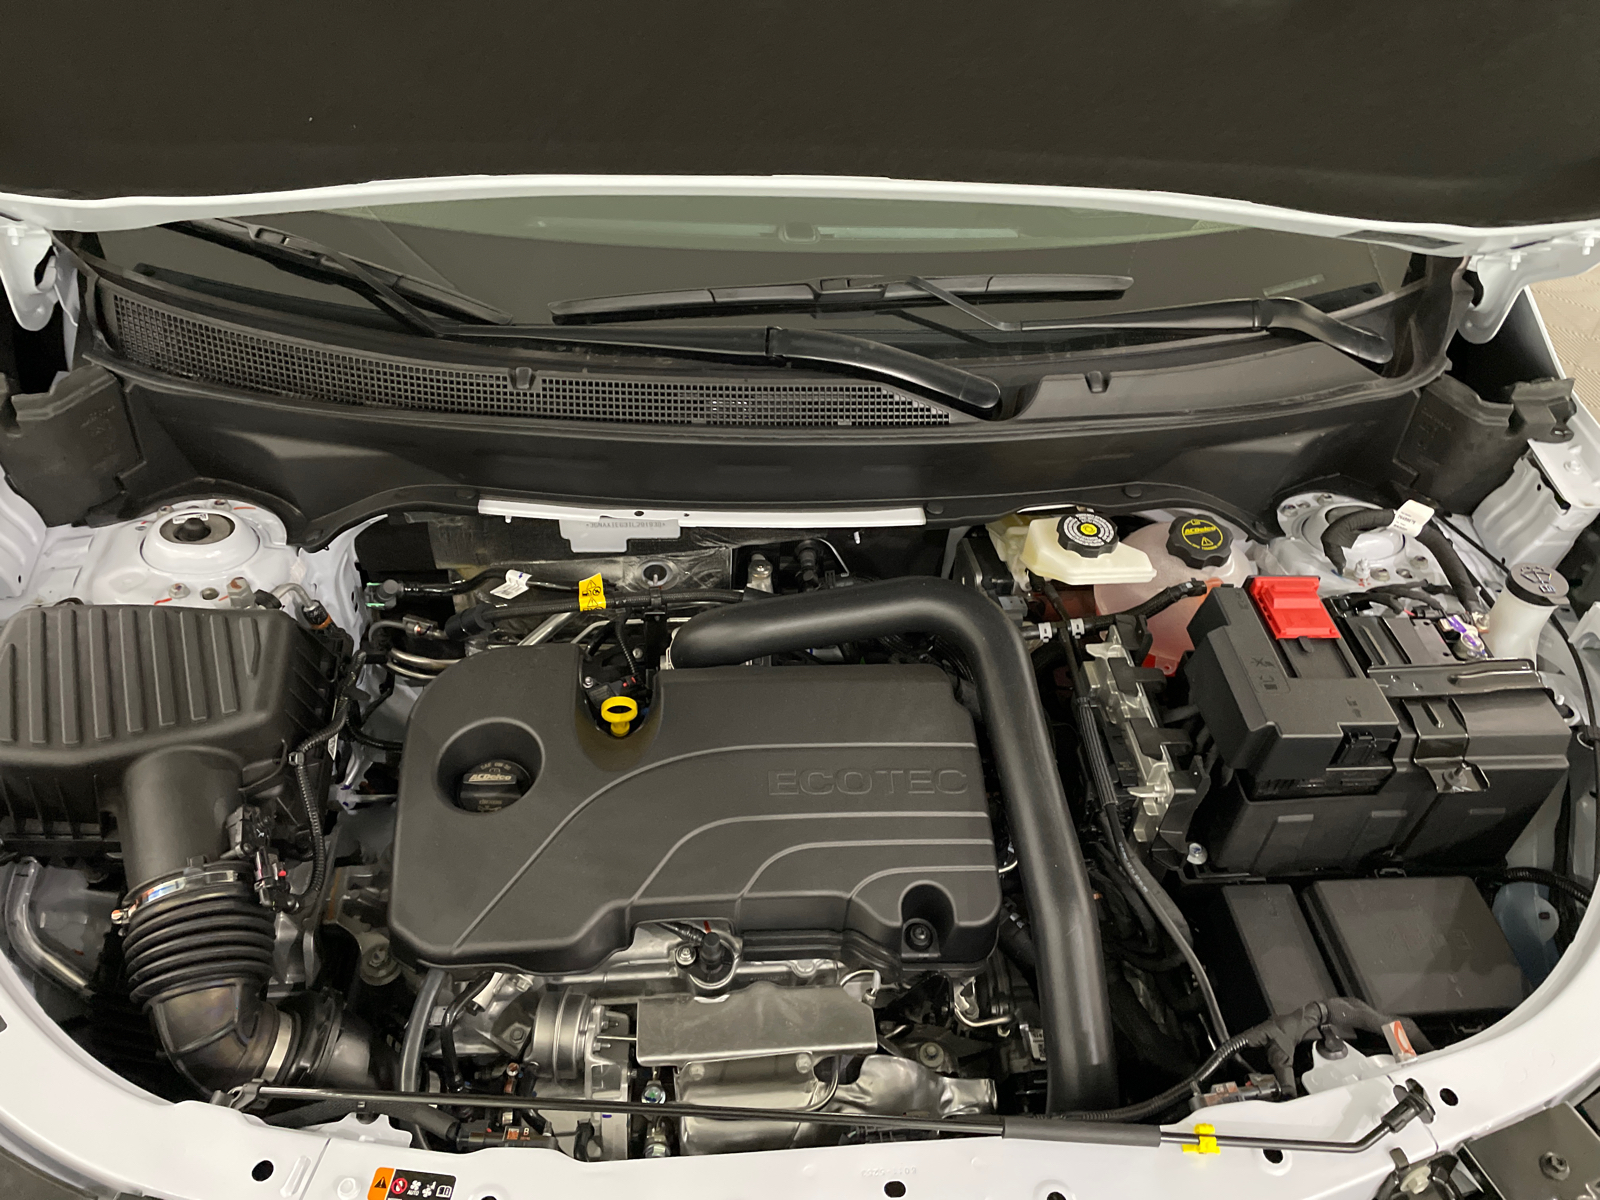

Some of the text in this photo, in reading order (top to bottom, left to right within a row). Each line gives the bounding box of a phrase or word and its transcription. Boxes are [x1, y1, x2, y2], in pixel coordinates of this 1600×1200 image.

[468, 772, 513, 782] ACDelco
[767, 768, 969, 796] ECOTEC
[406, 1189, 420, 1197] AUTO
